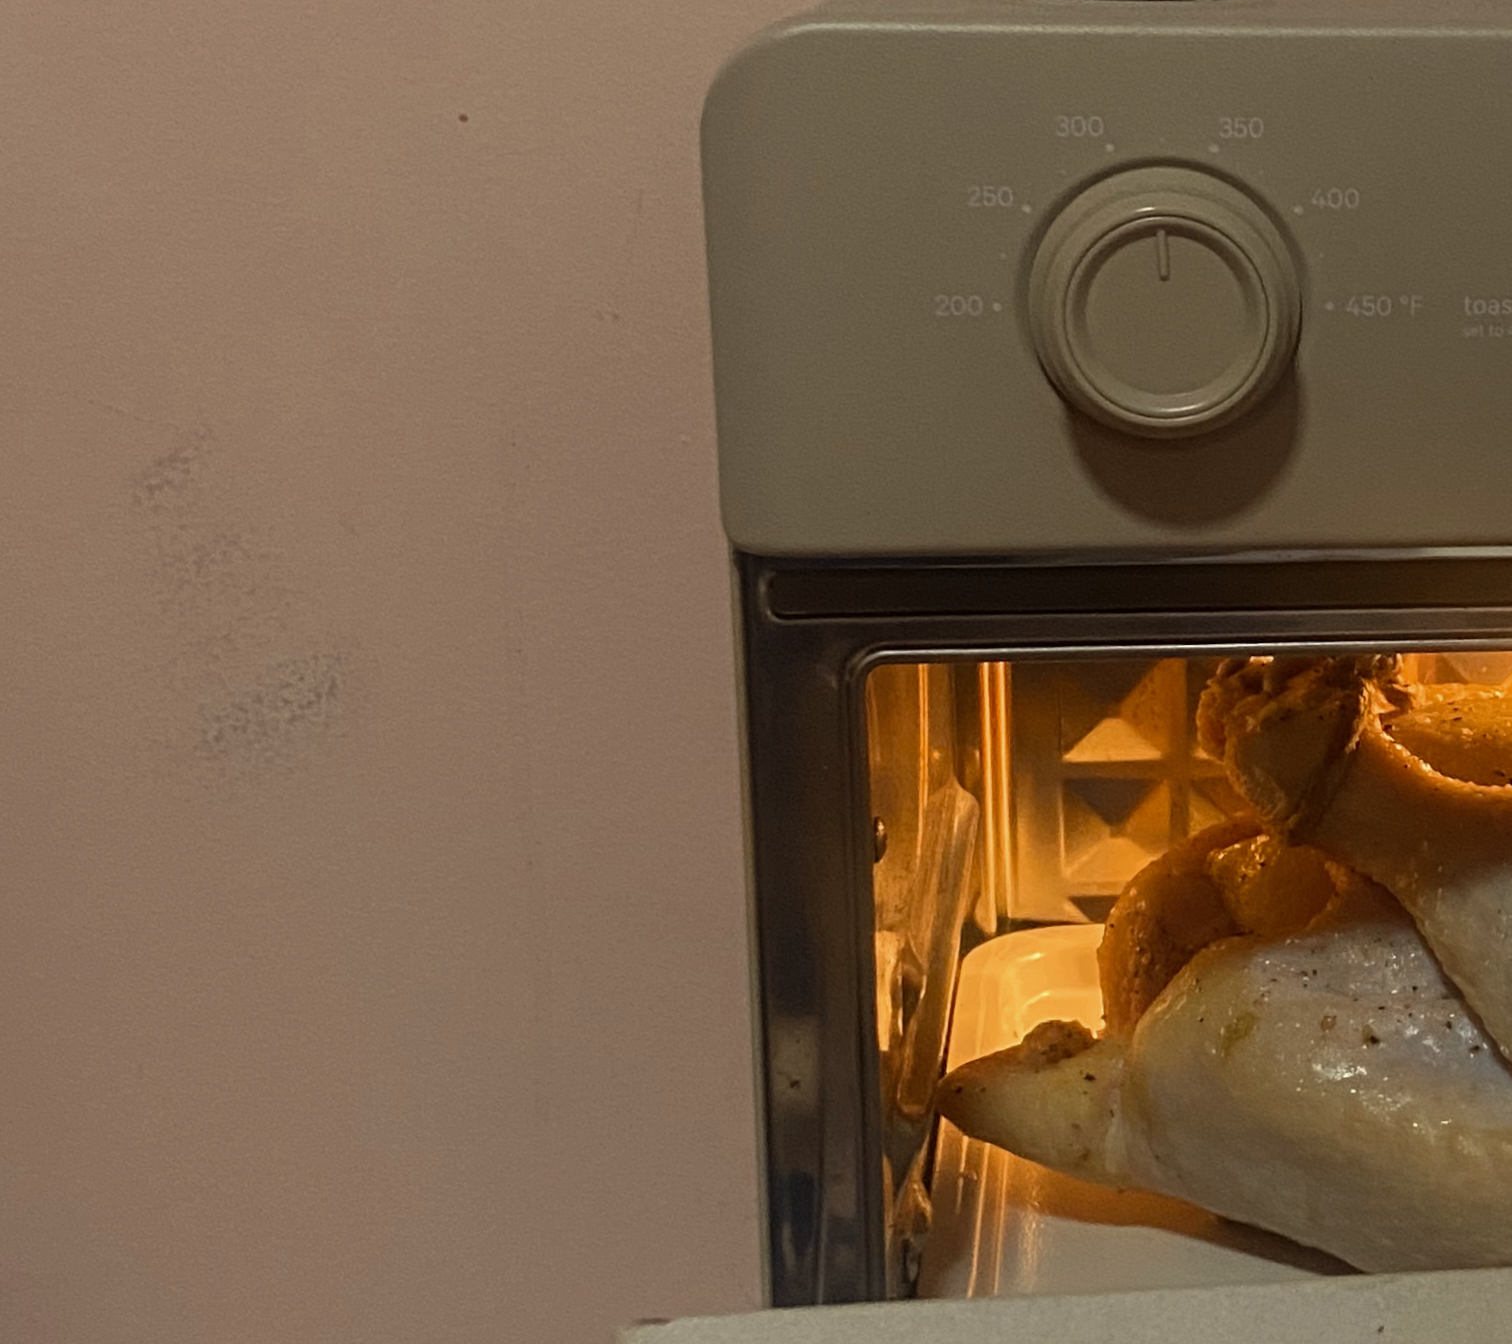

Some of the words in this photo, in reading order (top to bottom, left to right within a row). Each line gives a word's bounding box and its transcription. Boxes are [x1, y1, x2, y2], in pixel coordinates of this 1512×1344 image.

[1055, 115, 1105, 139] 300
[1218, 116, 1265, 139] 350
[967, 186, 1014, 208] 250
[1310, 187, 1361, 209] 400
[934, 295, 983, 316] 200
[1345, 295, 1392, 317] 450
